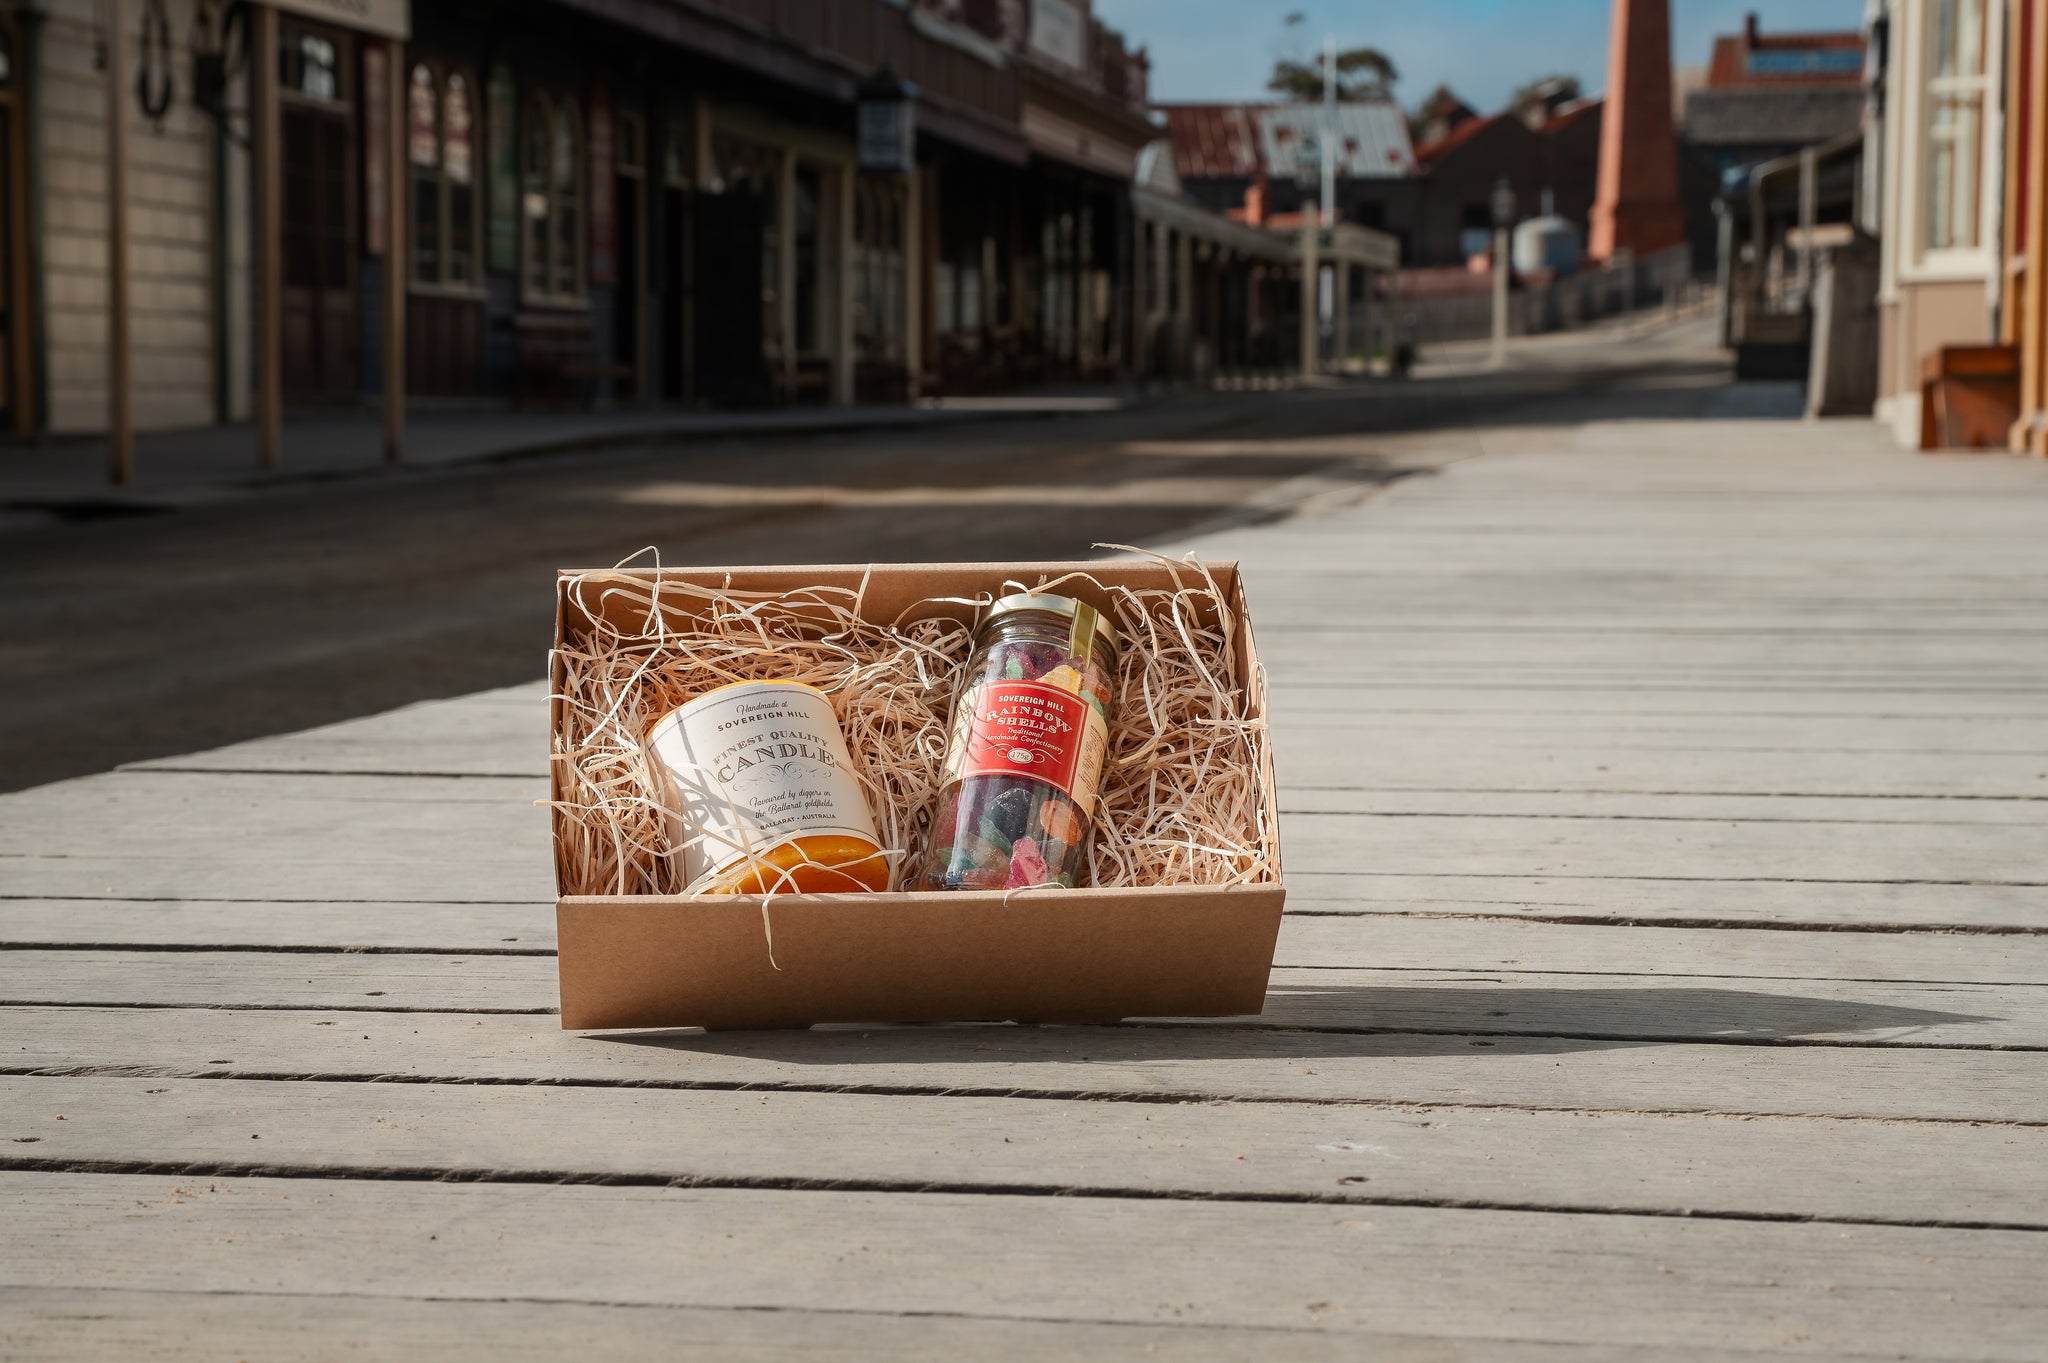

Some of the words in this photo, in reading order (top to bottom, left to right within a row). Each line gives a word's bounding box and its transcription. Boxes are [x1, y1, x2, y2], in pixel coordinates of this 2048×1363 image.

[736, 700, 779, 715] Handmade
[998, 695, 1045, 706] SOVEREIGN
[1046, 700, 1065, 713] HILL
[717, 711, 783, 732] SOVEREIGN
[787, 710, 810, 719] HILL
[986, 705, 1073, 733] RAINBOW
[997, 717, 1058, 734] SHELLS
[1007, 726, 1045, 739] Traditional
[713, 734, 765, 767] FINEST
[769, 730, 829, 748] QUALITY
[1020, 735, 1065, 755] Confectionery
[717, 743, 836, 784] CANDLE
[1010, 751, 1031, 761] 175g
[749, 791, 786, 807] Favoured
[788, 789, 796, 800] by
[798, 788, 822, 799] diggers
[755, 809, 766, 819] the
[767, 800, 803, 815] Ballarat
[804, 799, 834, 810] goldfields
[760, 816, 796, 831] BALLARAT
